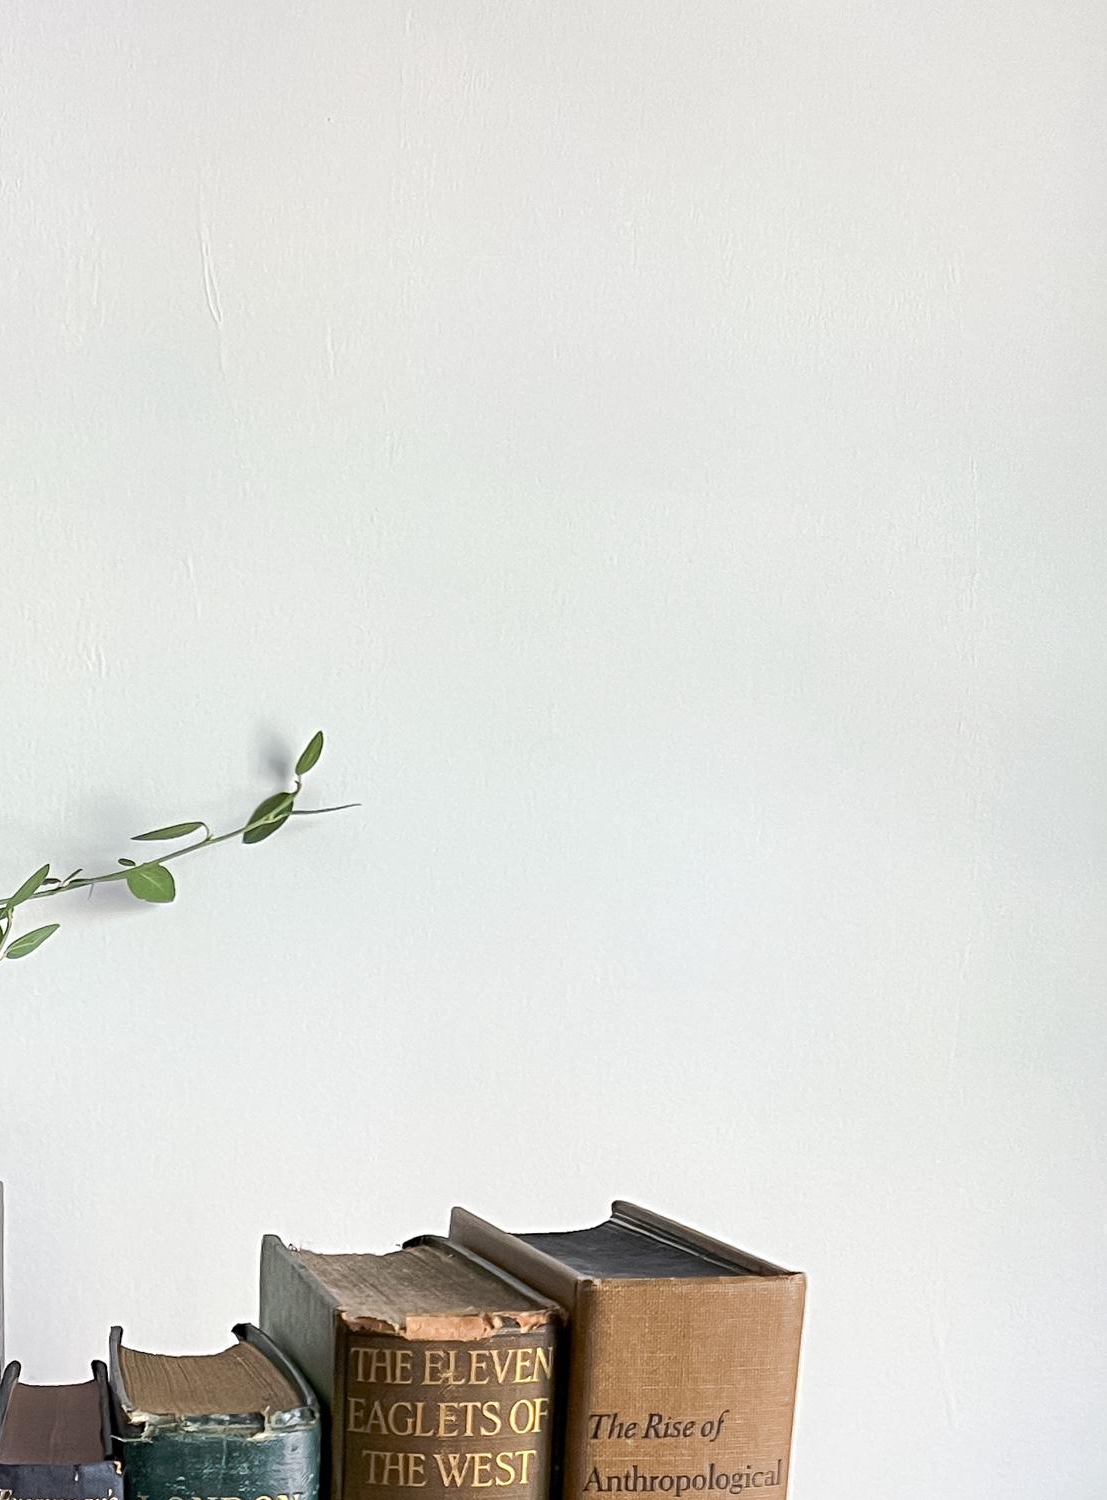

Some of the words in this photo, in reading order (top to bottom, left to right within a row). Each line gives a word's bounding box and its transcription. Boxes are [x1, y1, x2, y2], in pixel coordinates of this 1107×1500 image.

[350, 1347, 414, 1385] THE
[422, 1347, 554, 1386] ELEVEN
[347, 1397, 502, 1438] EAGLETS
[509, 1398, 549, 1434] OF
[589, 1413, 637, 1440] The
[641, 1412, 696, 1440] Rise
[700, 1409, 730, 1442] of
[362, 1450, 427, 1487] THE
[433, 1450, 537, 1488] WEST
[583, 1459, 783, 1497] Anthropological
